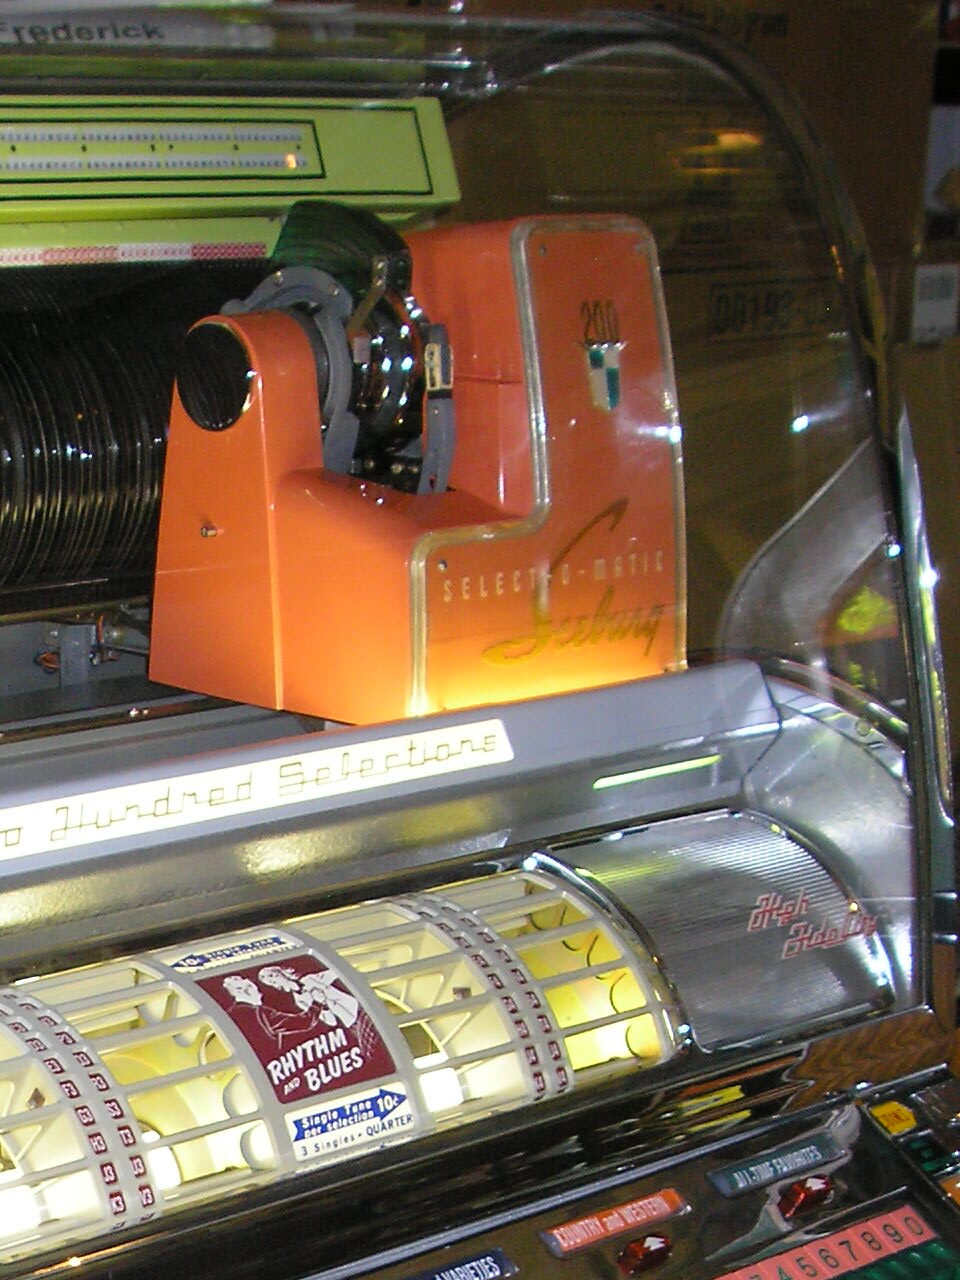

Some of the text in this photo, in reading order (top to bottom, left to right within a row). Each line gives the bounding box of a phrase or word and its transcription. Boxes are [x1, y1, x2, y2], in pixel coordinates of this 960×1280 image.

[580, 298, 622, 344] 200
[481, 497, 666, 667] Seeburg
[50, 771, 253, 841] Hundred
[278, 733, 498, 794] Selections
[747, 888, 809, 932] High
[267, 1028, 348, 1085] RHYTHM
[283, 1046, 364, 1096] AND BLUES
[301, 1110, 338, 1128] Single
[344, 1101, 371, 1115] Tune
[302, 1114, 414, 1157] 3 Singles QUARTER
[304, 1111, 375, 1140] per selection
[553, 1216, 605, 1248] COUNTRY
[796, 1257, 818, 1278] 5
[818, 1248, 839, 1269] 6
[838, 1240, 858, 1261] 7
[861, 1231, 882, 1252] 8
[882, 1223, 903, 1244] 9
